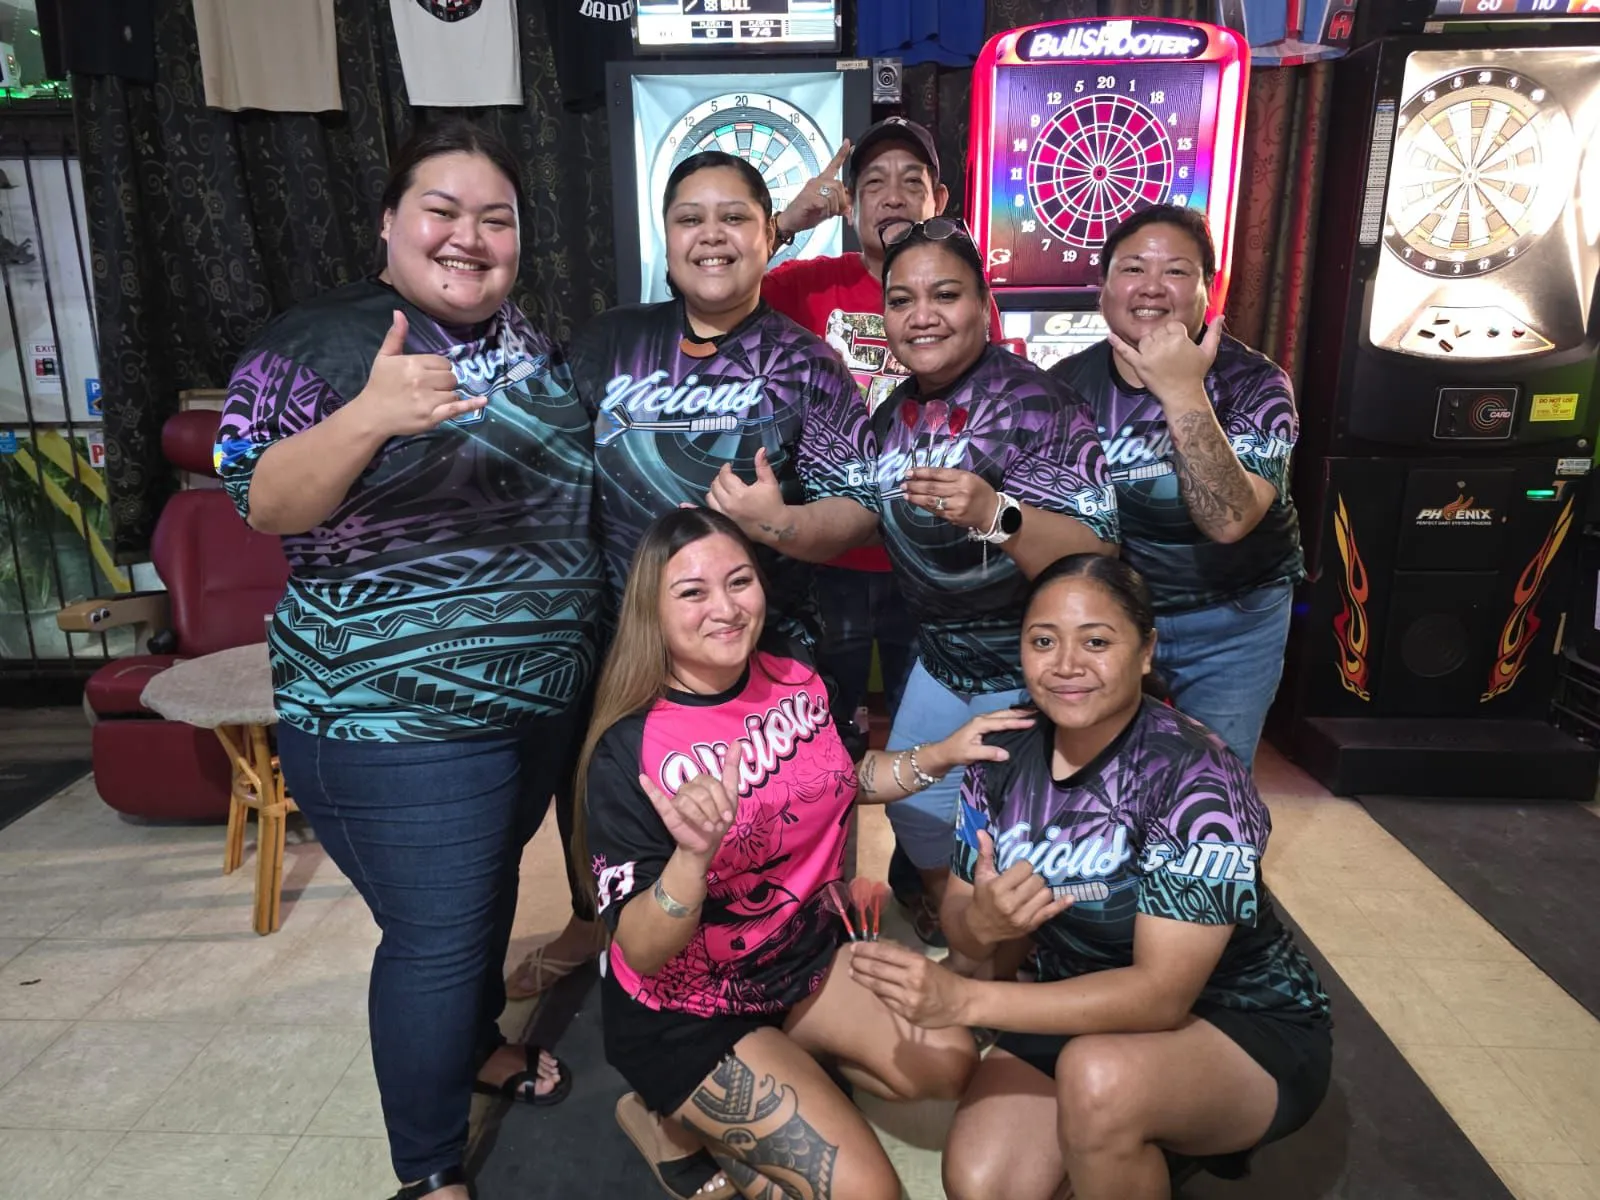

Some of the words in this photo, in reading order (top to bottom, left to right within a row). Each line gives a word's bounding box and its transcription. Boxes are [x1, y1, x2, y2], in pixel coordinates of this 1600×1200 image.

[1074, 80, 1085, 92] 5
[1096, 76, 1116, 89] 20
[1128, 79, 1136, 92] 1
[735, 95, 749, 107] 20
[1047, 93, 1062, 105] 12
[1150, 91, 1165, 103] 18
[711, 100, 718, 112] 5
[684, 116, 695, 127] 12
[789, 113, 800, 124] 18
[1030, 114, 1041, 127] 9
[1168, 113, 1178, 125] 4
[1010, 167, 1023, 180] 11
[1178, 166, 1189, 178] 6
[1041, 239, 1051, 251] 7
[1062, 250, 1077, 262] 19
[601, 370, 767, 415] Vicious
